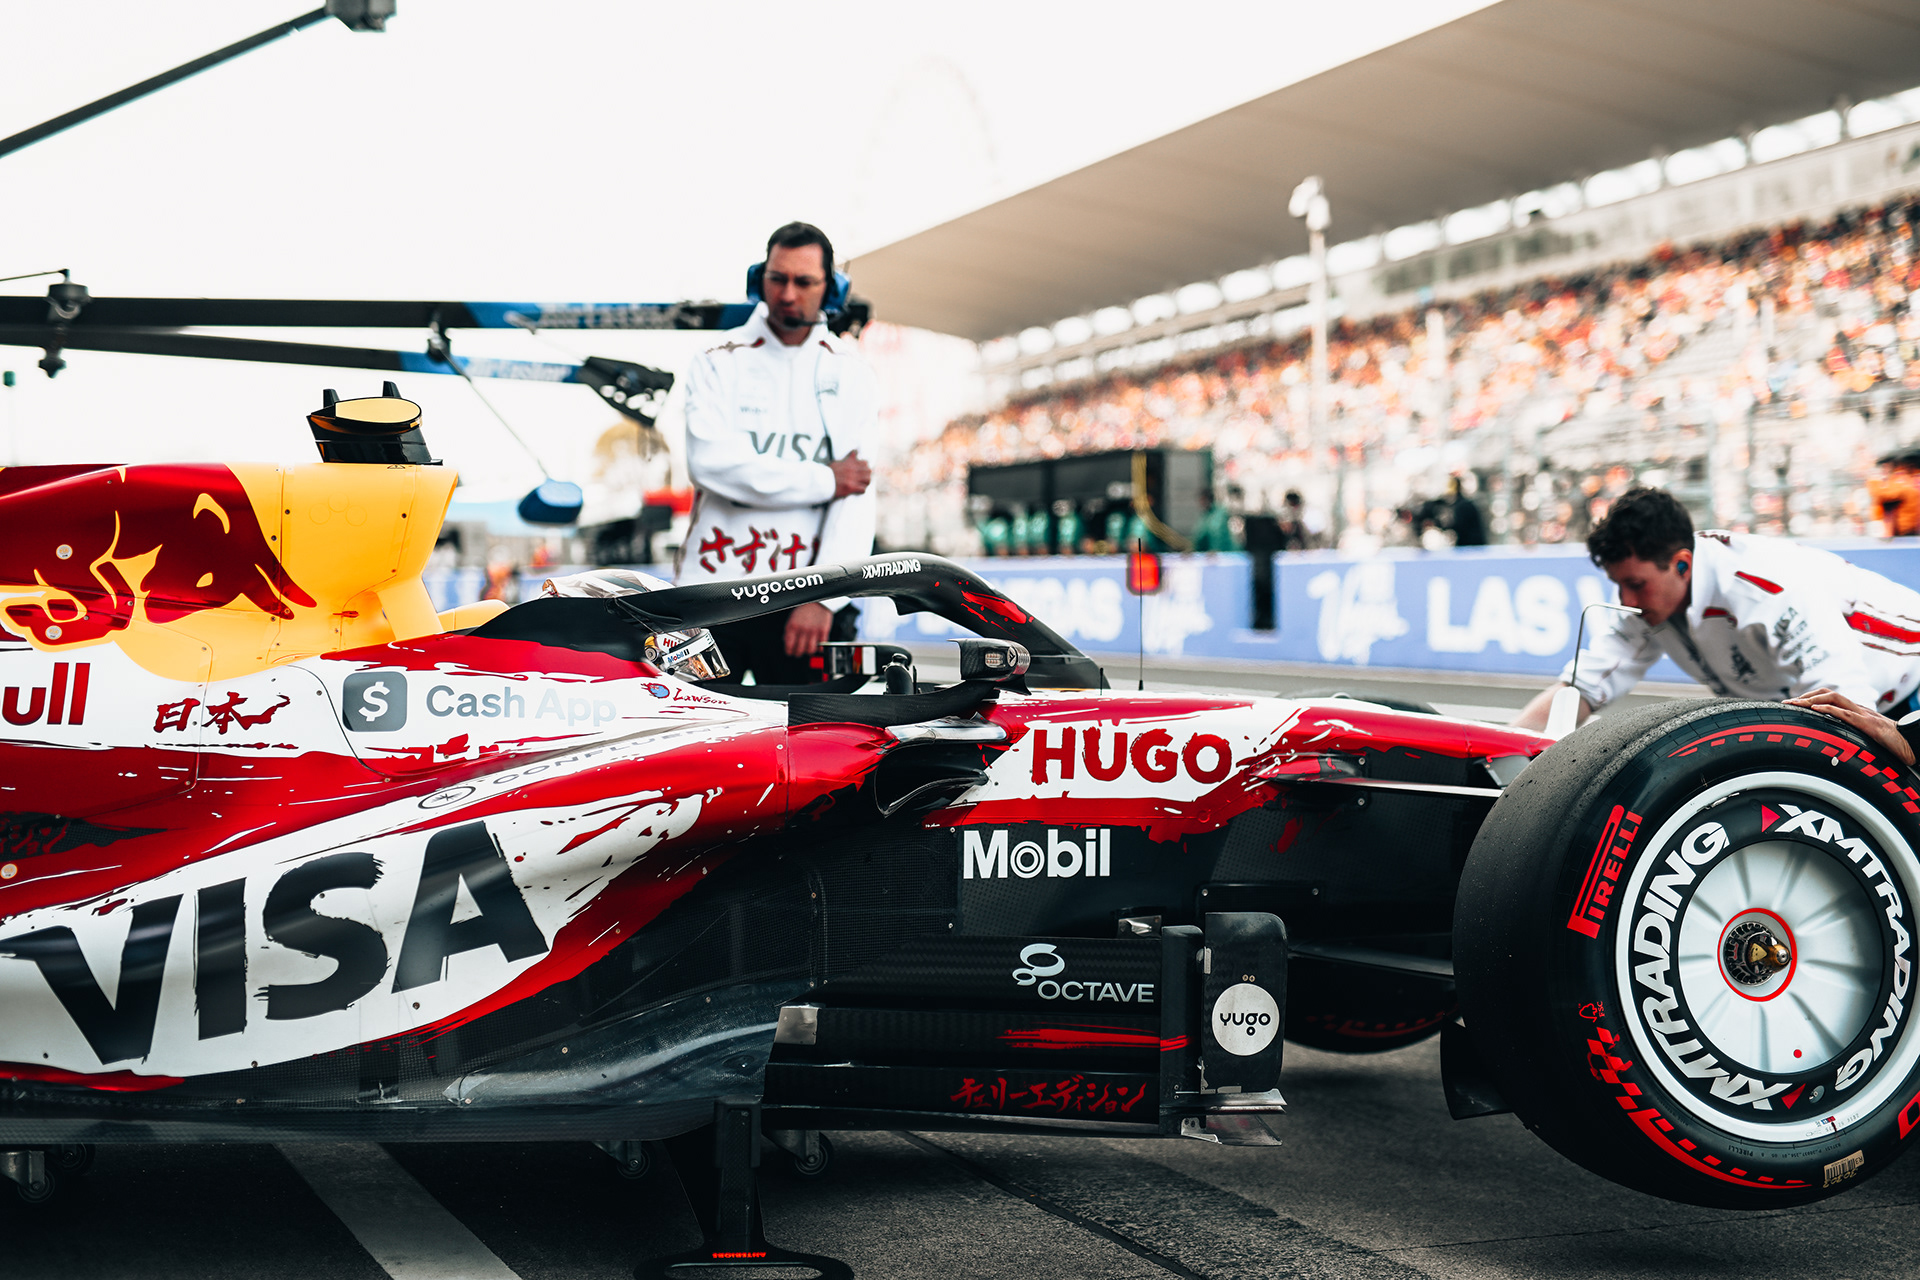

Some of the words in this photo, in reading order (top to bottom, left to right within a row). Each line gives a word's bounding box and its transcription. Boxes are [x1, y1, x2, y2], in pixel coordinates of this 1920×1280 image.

[750, 430, 832, 463] VISA
[730, 573, 823, 605] yugo.com
[862, 557, 921, 580] XMTRADING
[1427, 575, 1571, 656] LAS
[1, 662, 91, 726] ull
[153, 691, 291, 735] 日本
[425, 686, 526, 718] Cash
[534, 686, 617, 727] App
[673, 687, 731, 705] Lawson
[1031, 726, 1233, 787] HUGO
[963, 828, 1111, 880] Mobil
[1567, 804, 1644, 939] PIRELLI
[0, 820, 550, 1065] VISA
[1775, 803, 1911, 1091] XMTRADING
[1634, 821, 1793, 1111] XMTRADING
[1037, 980, 1155, 1004] OCTAVE
[1219, 1012, 1272, 1036] yugo
[950, 1073, 1148, 1114] チェリーエディション
[1728, 1144, 1754, 1157] PIRELLI
